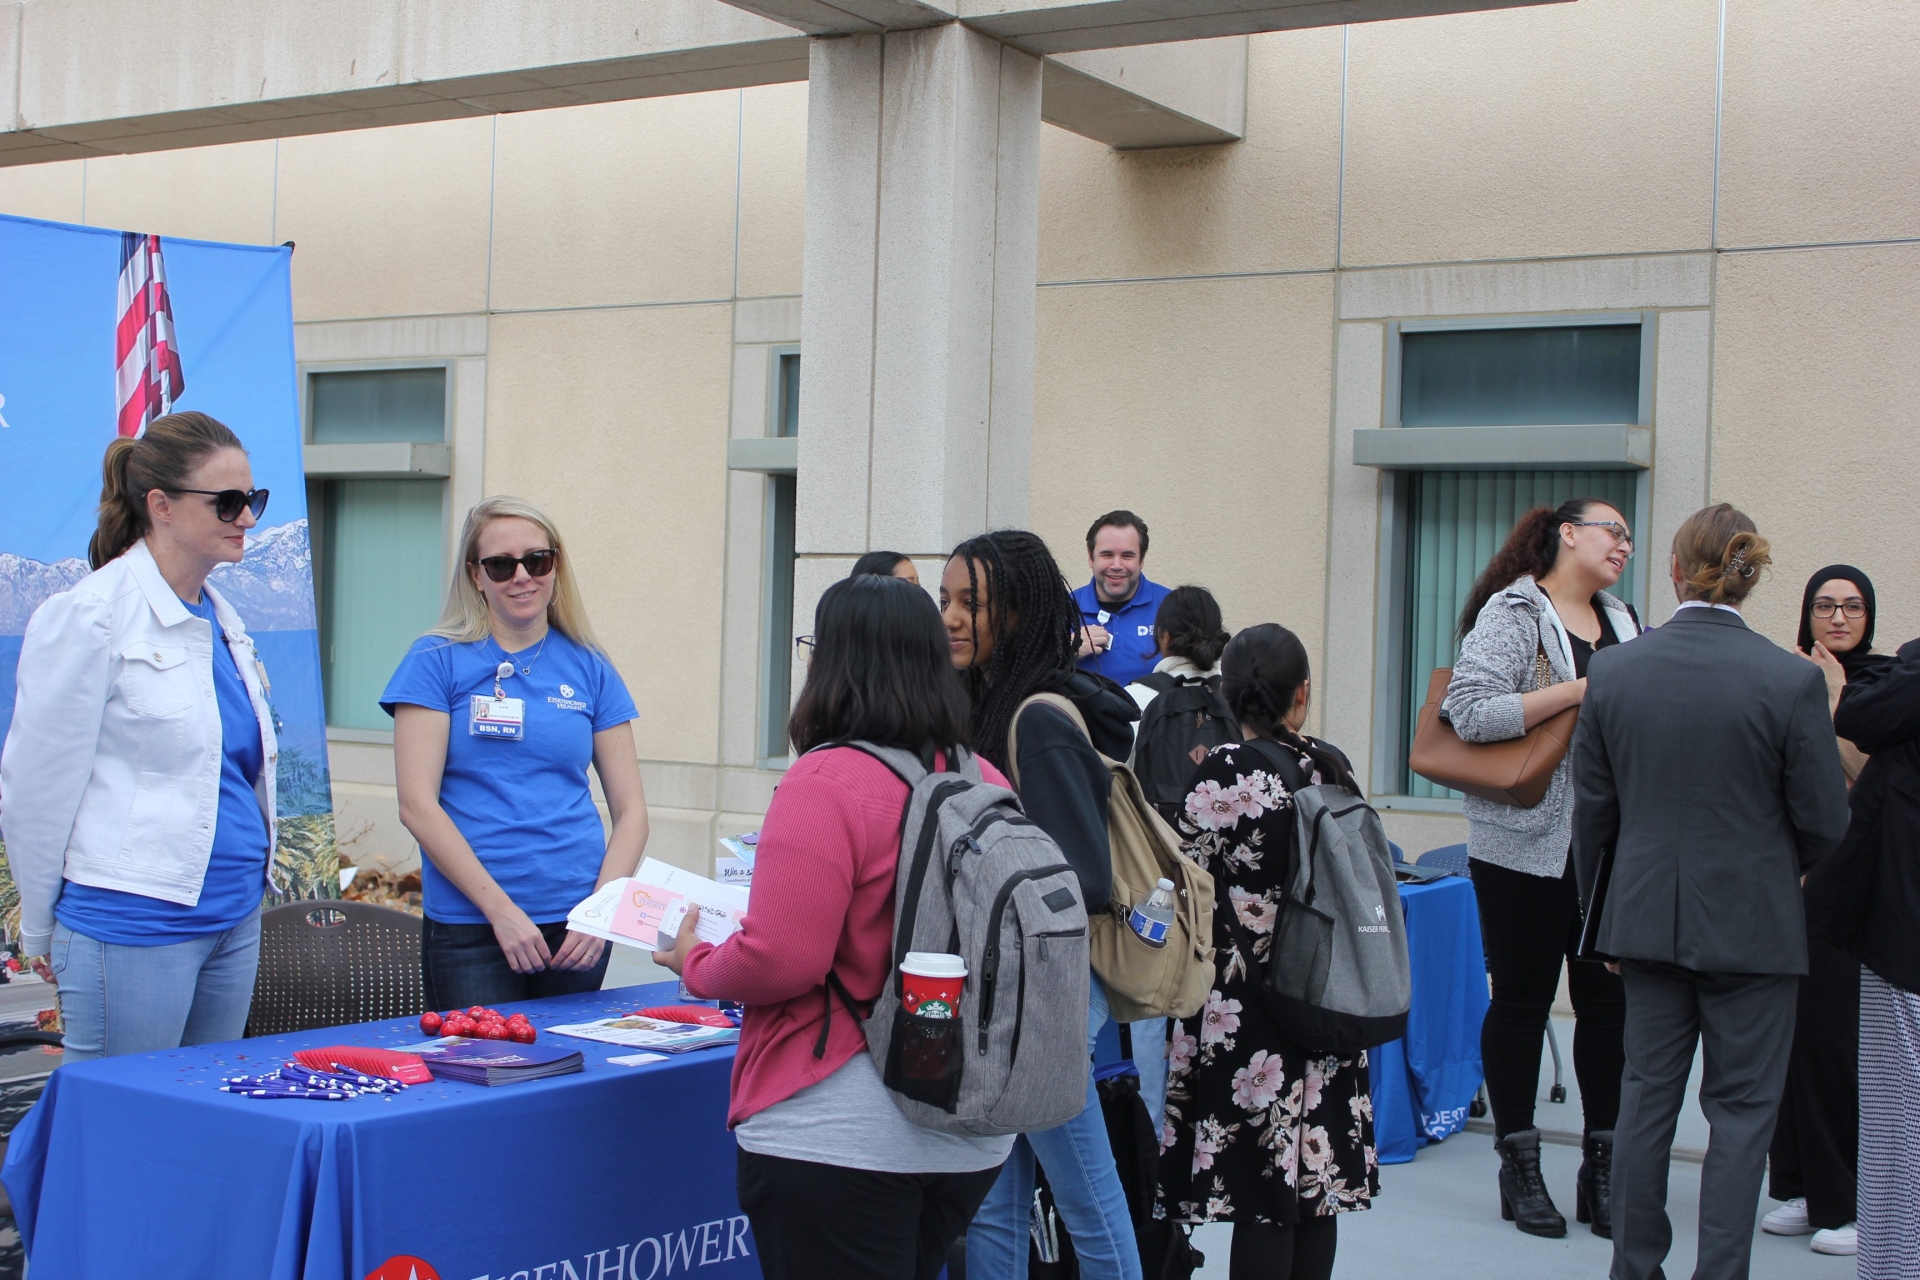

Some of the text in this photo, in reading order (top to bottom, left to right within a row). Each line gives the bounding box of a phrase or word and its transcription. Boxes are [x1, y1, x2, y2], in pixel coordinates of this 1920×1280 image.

[479, 724, 516, 734] BSN, RN
[639, 899, 668, 911] COUNTY
[1358, 925, 1378, 933] KAISER
